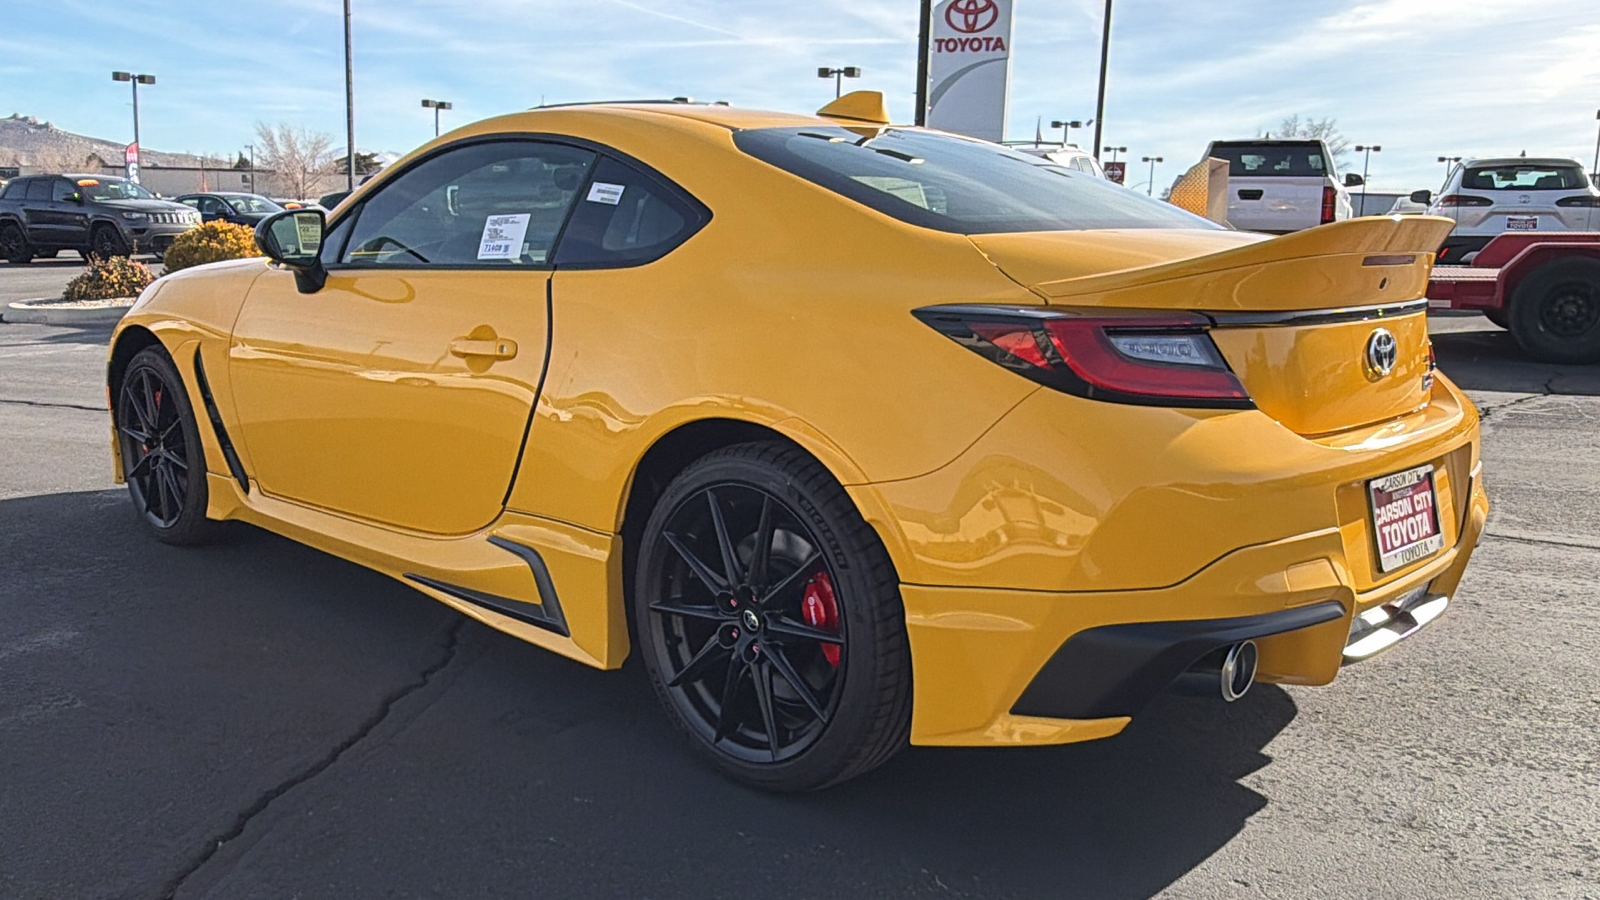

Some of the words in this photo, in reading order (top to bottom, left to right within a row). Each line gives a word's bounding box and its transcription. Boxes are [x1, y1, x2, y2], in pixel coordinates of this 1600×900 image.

[934, 37, 1006, 53] TOYOTA
[1385, 473, 1407, 489] CARSON
[1375, 497, 1412, 526] CARSON
[1414, 490, 1432, 511] CITY
[1382, 512, 1431, 550] TOYOTA
[1400, 542, 1429, 563] TOYOTA
